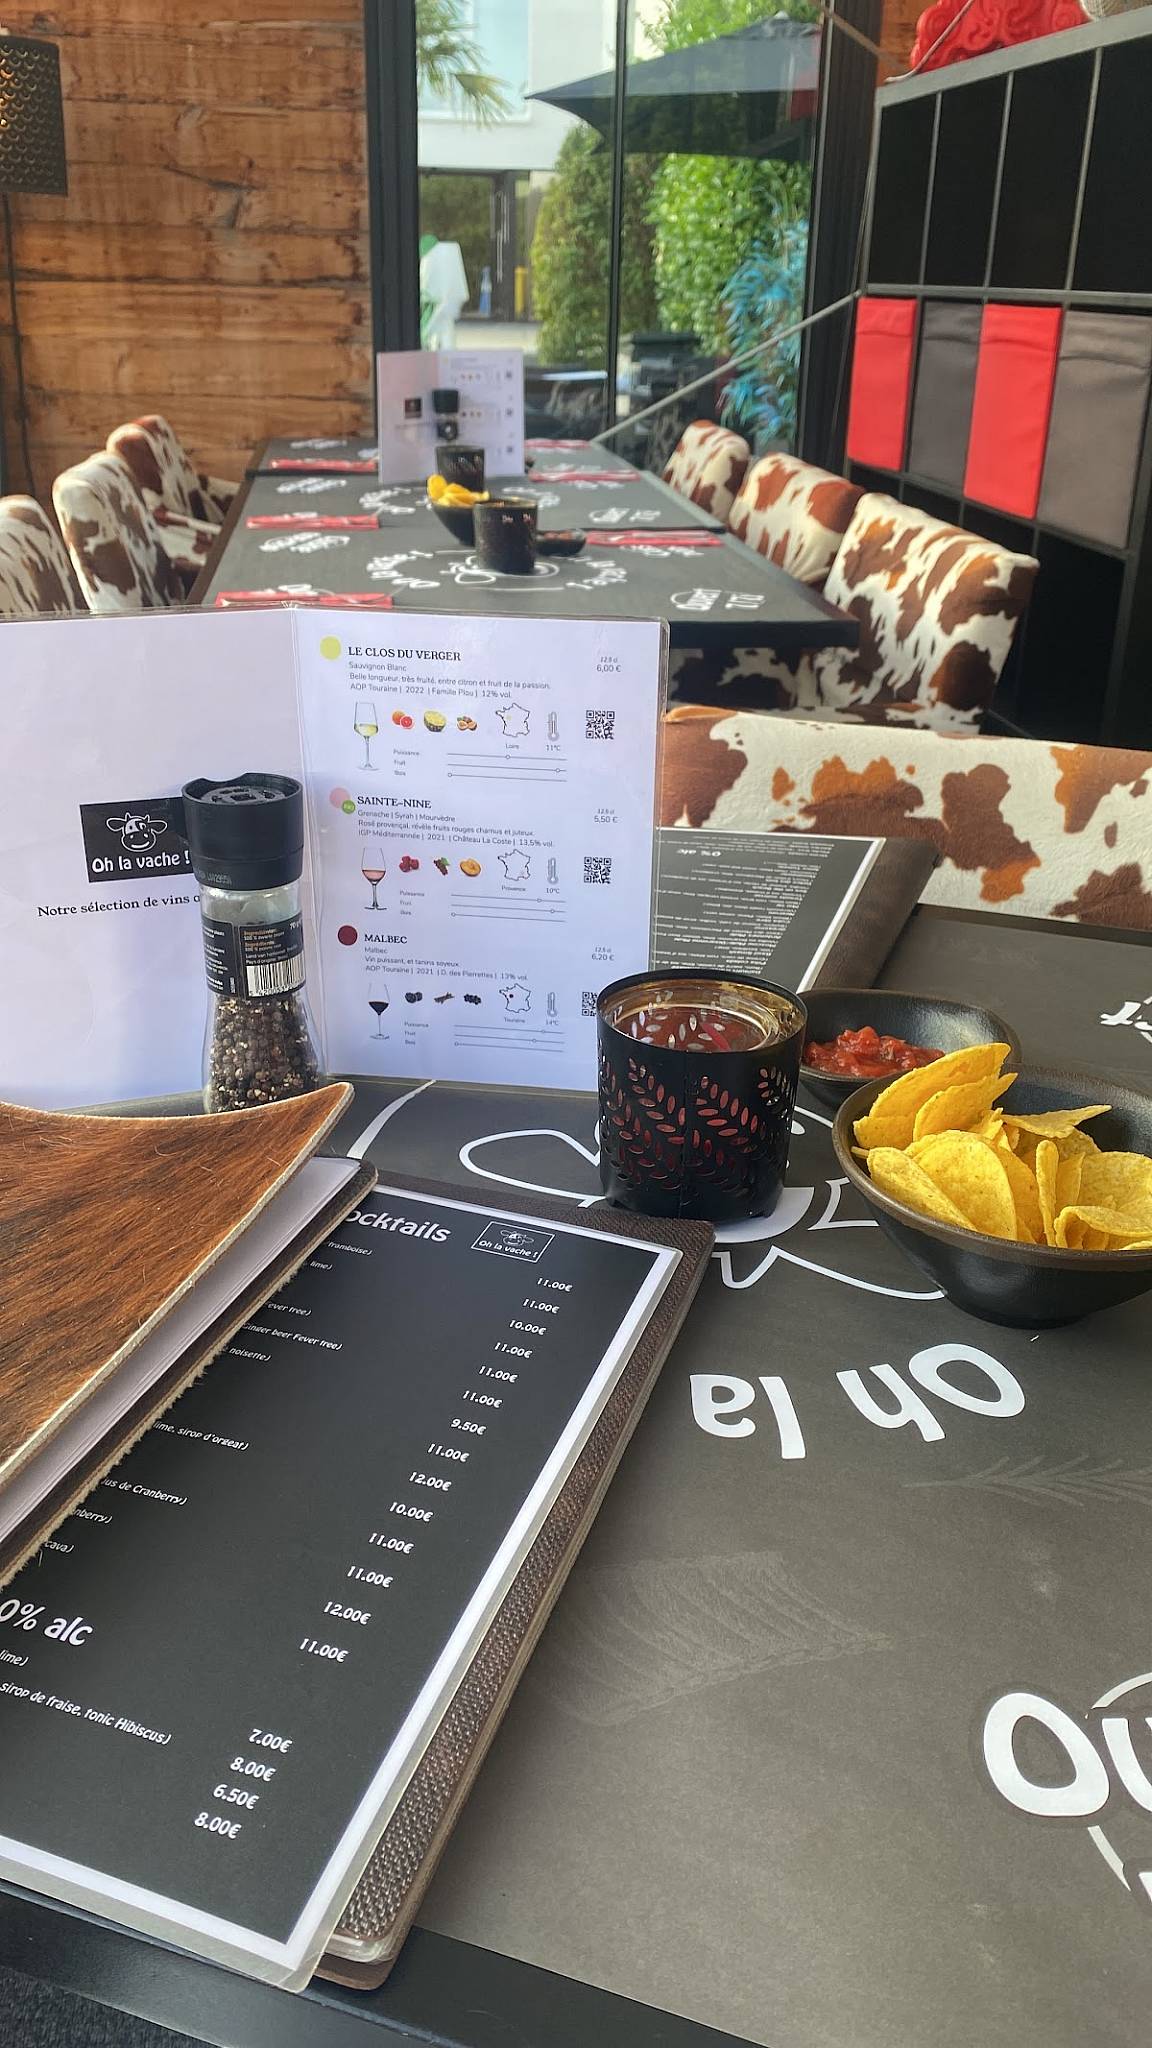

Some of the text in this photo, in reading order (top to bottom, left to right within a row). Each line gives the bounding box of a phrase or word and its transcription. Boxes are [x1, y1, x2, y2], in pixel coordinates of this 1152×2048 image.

[348, 646, 461, 661] LE CLOS DU VERGER
[348, 662, 385, 671] Sauvignon
[596, 664, 614, 672] 6,00
[368, 683, 398, 692] Touraine
[405, 686, 425, 694] 2022
[482, 689, 498, 697] 12%
[357, 796, 432, 808] SAINTE-NINE
[358, 810, 389, 818] Grenache
[395, 811, 414, 820] Syrah
[427, 833, 445, 841] 2021
[492, 837, 512, 845] Coste
[452, 826, 475, 834] rouges
[91, 850, 190, 873] Oh la vache !
[37, 905, 77, 917] Notre
[80, 900, 140, 914] sélection
[143, 897, 159, 907] de
[161, 894, 190, 906] vins
[364, 934, 408, 944] MALBEC
[364, 946, 388, 954] Malbec
[344, 1209, 452, 1243] ocktails
[479, 1240, 492, 1249] Oh
[494, 1241, 503, 1250] la
[504, 1244, 532, 1257] vache
[537, 1277, 573, 1293] 11.00€
[268, 1302, 288, 1312] ever
[523, 1298, 560, 1314] 11.00€
[271, 1328, 292, 1339] beer
[293, 1333, 320, 1345] Fever
[509, 1319, 547, 1336] 10.00€
[229, 1346, 272, 1362] noisette)
[494, 1341, 532, 1359] 11.00€
[478, 1365, 518, 1383] 11.00€
[463, 1390, 503, 1409] 11.00€
[690, 1343, 1025, 1459] Oh la
[178, 1427, 203, 1438] sirop
[450, 1418, 487, 1435] 9.50€
[427, 1443, 470, 1463] 11.00€
[409, 1471, 452, 1492] 12.00€
[118, 1481, 133, 1491] de
[132, 1484, 188, 1506] Cranberry)
[72, 1508, 113, 1525] nberry)
[389, 1501, 434, 1523] 10.00€
[368, 1532, 414, 1555] 11.00€
[347, 1565, 394, 1589] 11.00€
[323, 1601, 371, 1626] 12.00€
[0, 1599, 94, 1647] 0% alc
[299, 1638, 349, 1663] 11.00€
[0, 1681, 172, 1746] sirop de fraise, tonic Hibiscus)
[249, 1728, 293, 1753] 7.00€
[229, 1757, 277, 1782] 8.00€
[212, 1783, 260, 1810] 6.50€
[194, 1812, 242, 1840] 8.00€
